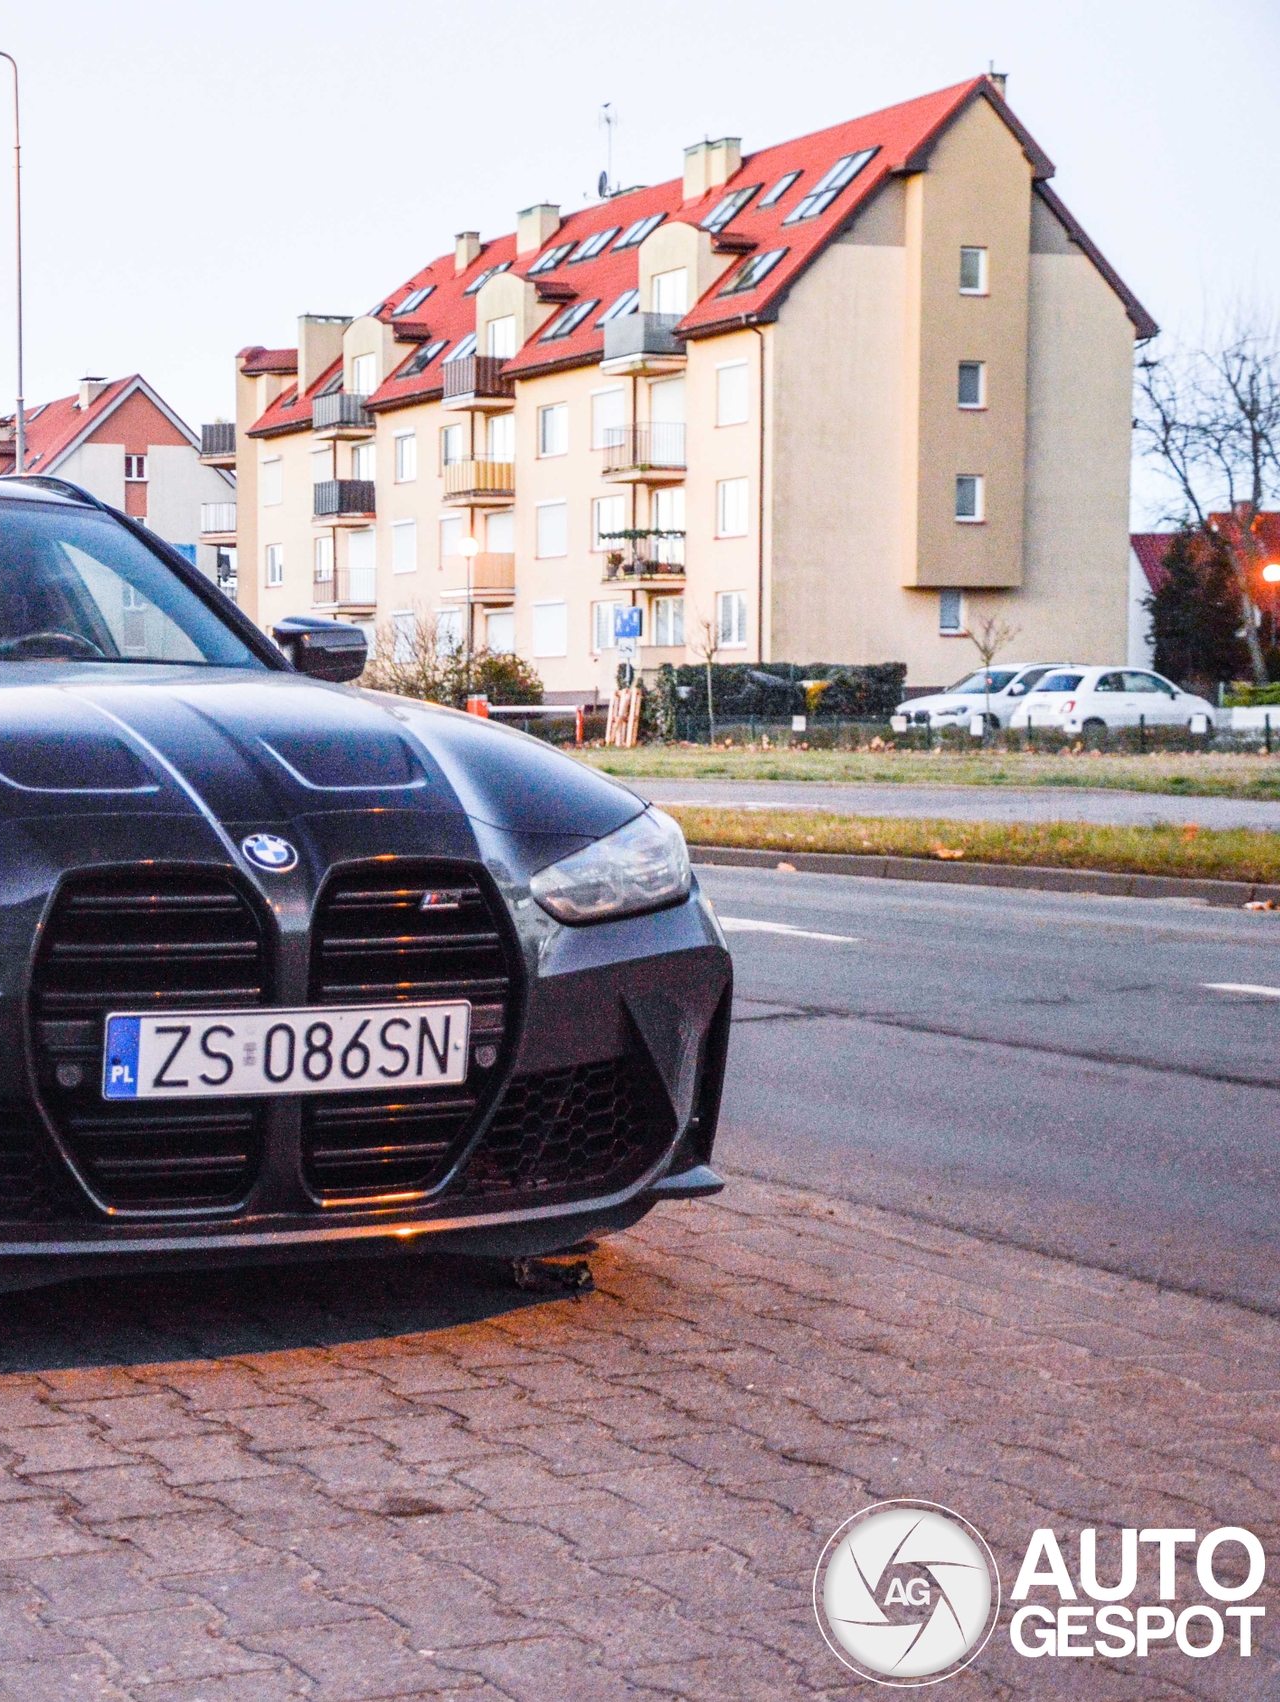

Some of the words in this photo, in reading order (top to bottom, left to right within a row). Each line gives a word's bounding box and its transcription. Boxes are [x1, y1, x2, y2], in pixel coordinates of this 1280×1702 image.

[111, 1065, 134, 1083] PL
[153, 1024, 235, 1088] ZS
[264, 1015, 451, 1082] 086SN
